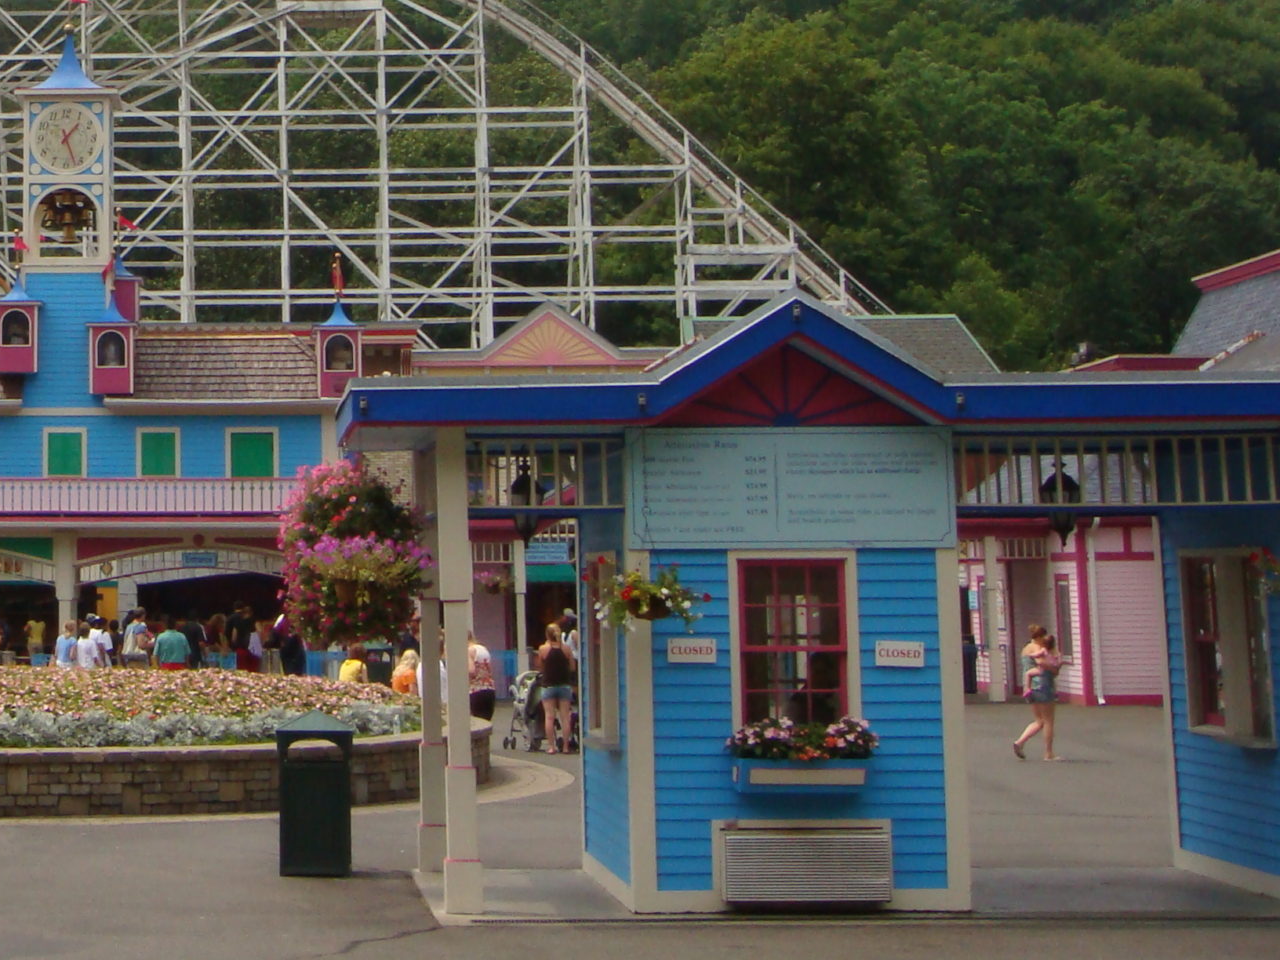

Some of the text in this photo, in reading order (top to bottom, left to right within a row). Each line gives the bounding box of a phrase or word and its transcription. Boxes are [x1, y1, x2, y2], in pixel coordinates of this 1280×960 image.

[49, 111, 58, 121] 11
[62, 108, 72, 118] 12
[39, 121, 49, 131] 10
[671, 645, 714, 656] CLOSED
[878, 647, 922, 659] CLOSED
